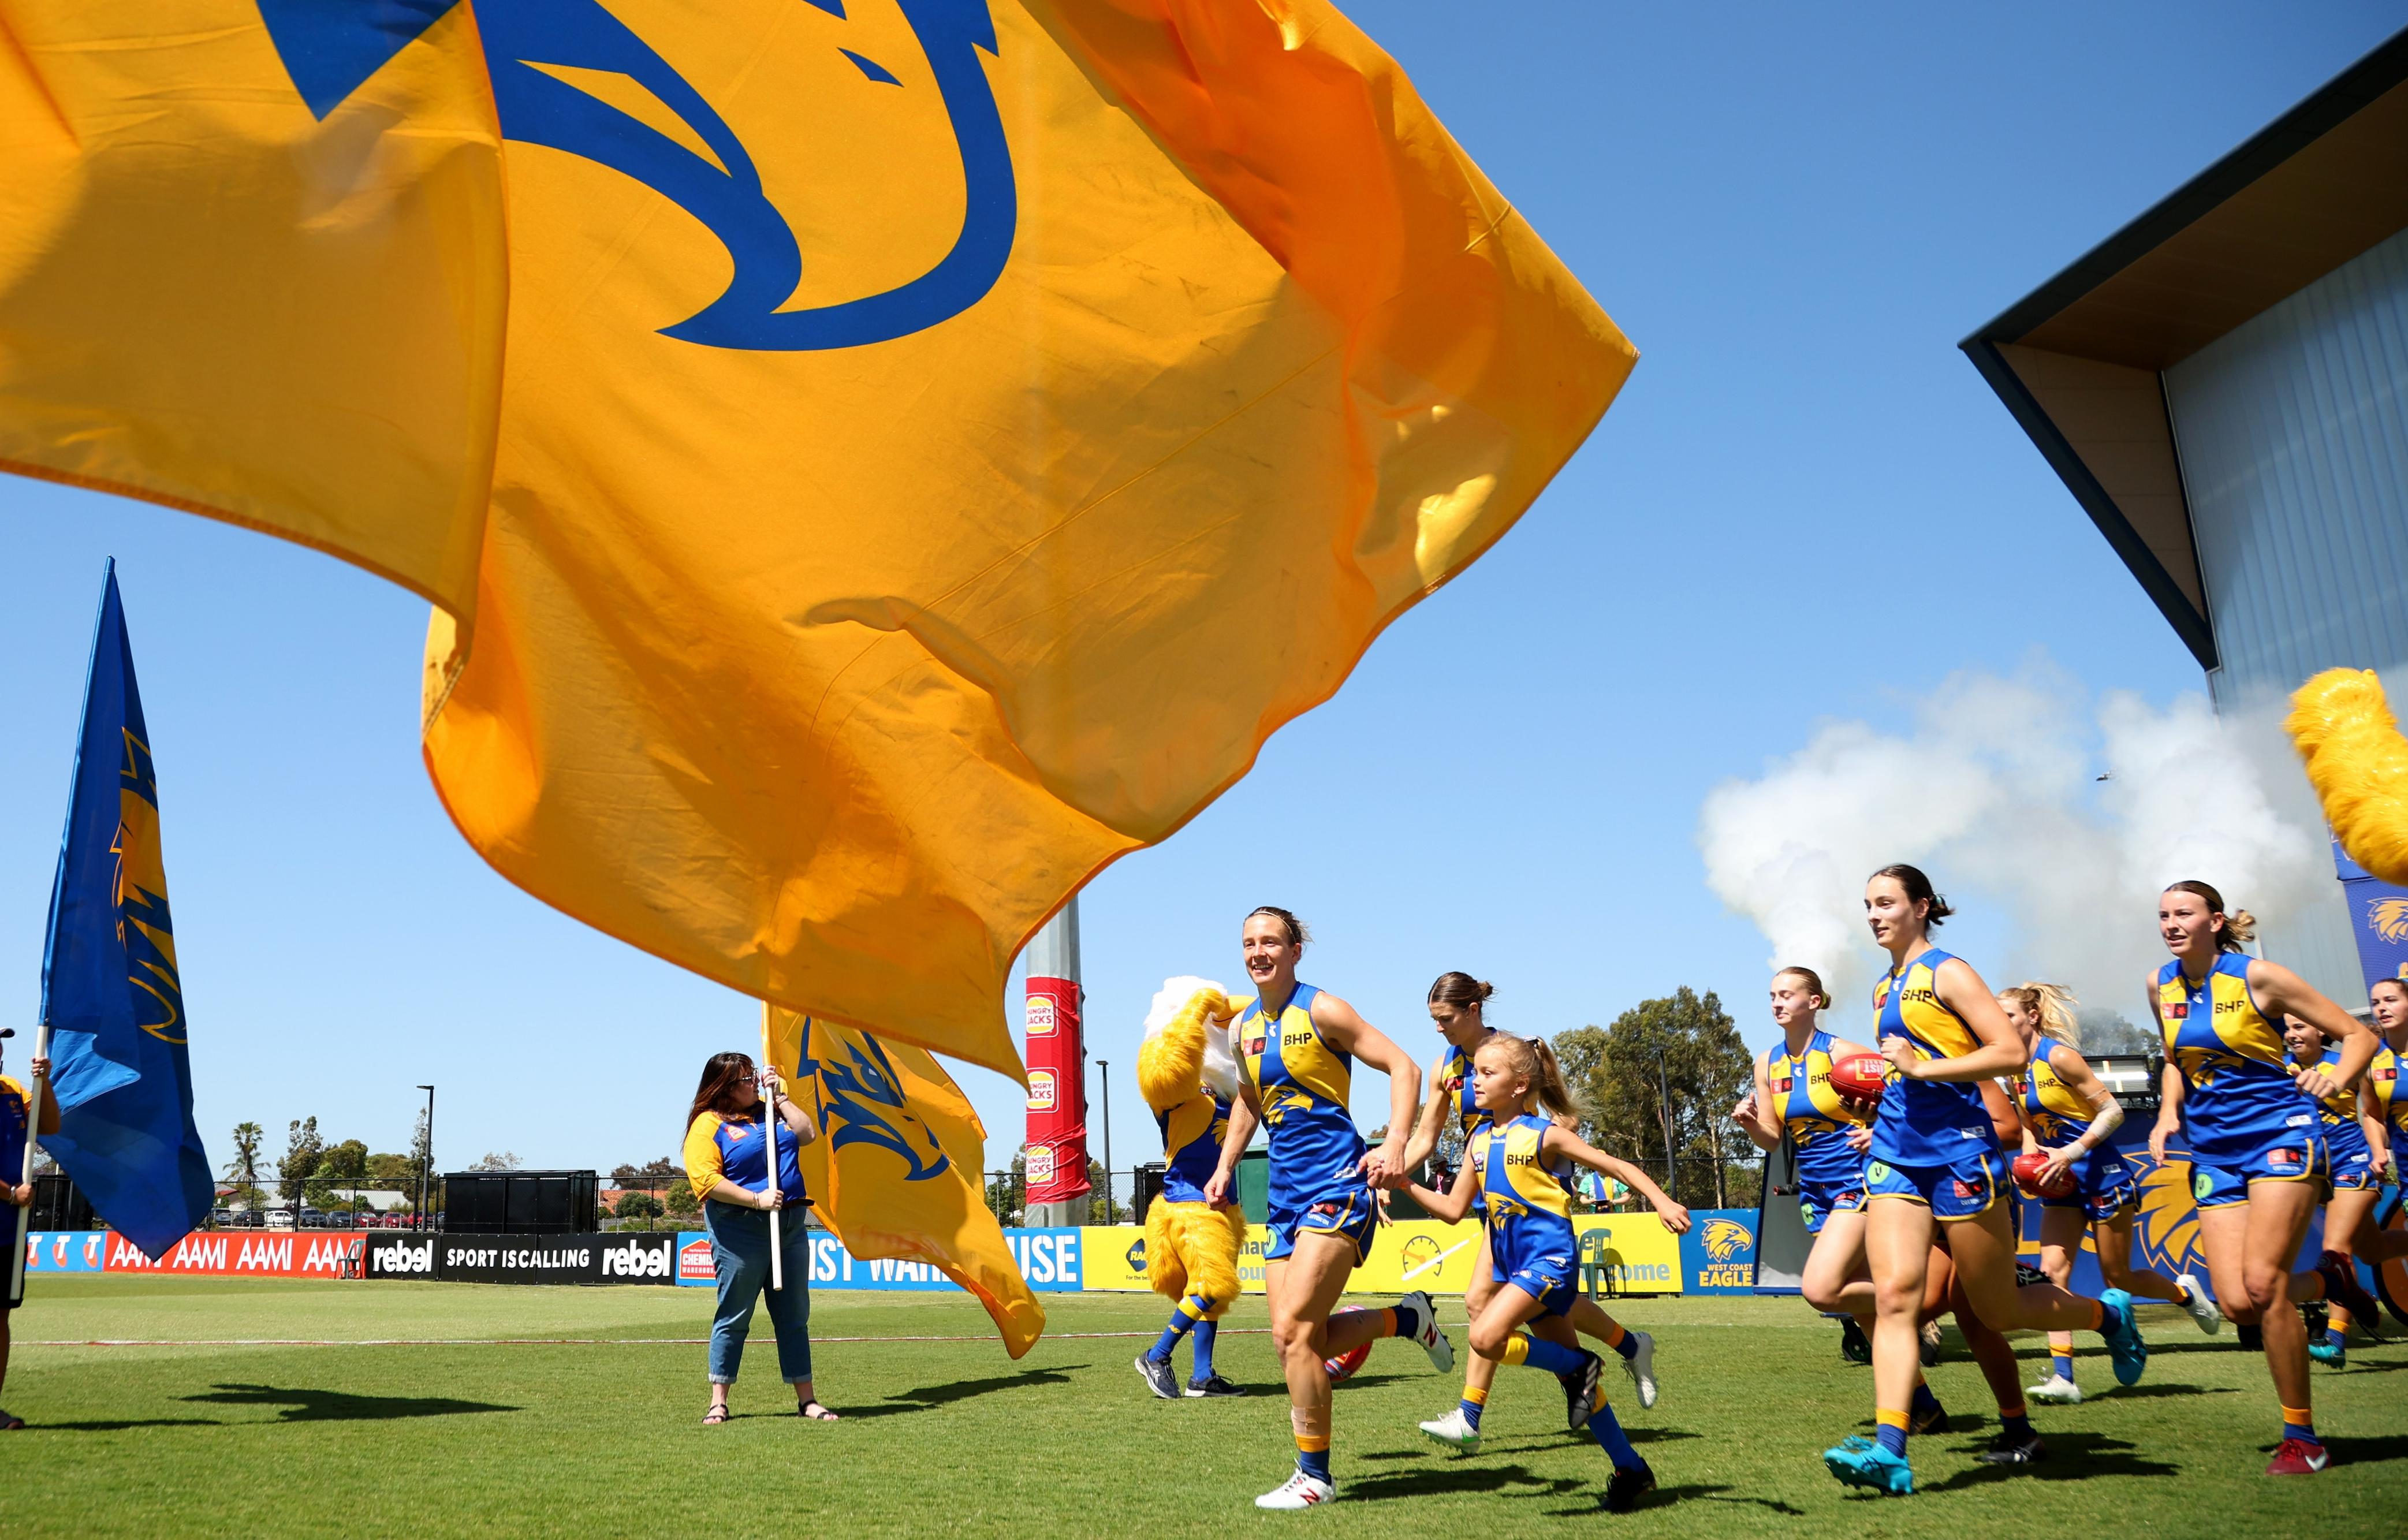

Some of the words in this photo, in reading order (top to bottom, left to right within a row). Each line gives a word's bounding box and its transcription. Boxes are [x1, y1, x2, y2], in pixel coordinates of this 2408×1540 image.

[1902, 989, 1933, 1002] BHP
[2215, 1000, 2245, 1014] BHP
[1284, 1032, 1313, 1046] BHP
[2038, 1078, 2056, 1089] BHP
[1507, 1154, 1534, 1166] BHP
[172, 1237, 228, 1270] AAMI
[236, 1237, 293, 1271] AAMI
[372, 1239, 433, 1273] rebel
[446, 1248, 498, 1267] SPORT
[602, 1239, 671, 1277] rebel
[683, 1253, 714, 1266] CHEMIS
[1698, 1271, 1753, 1287] EAGLE
